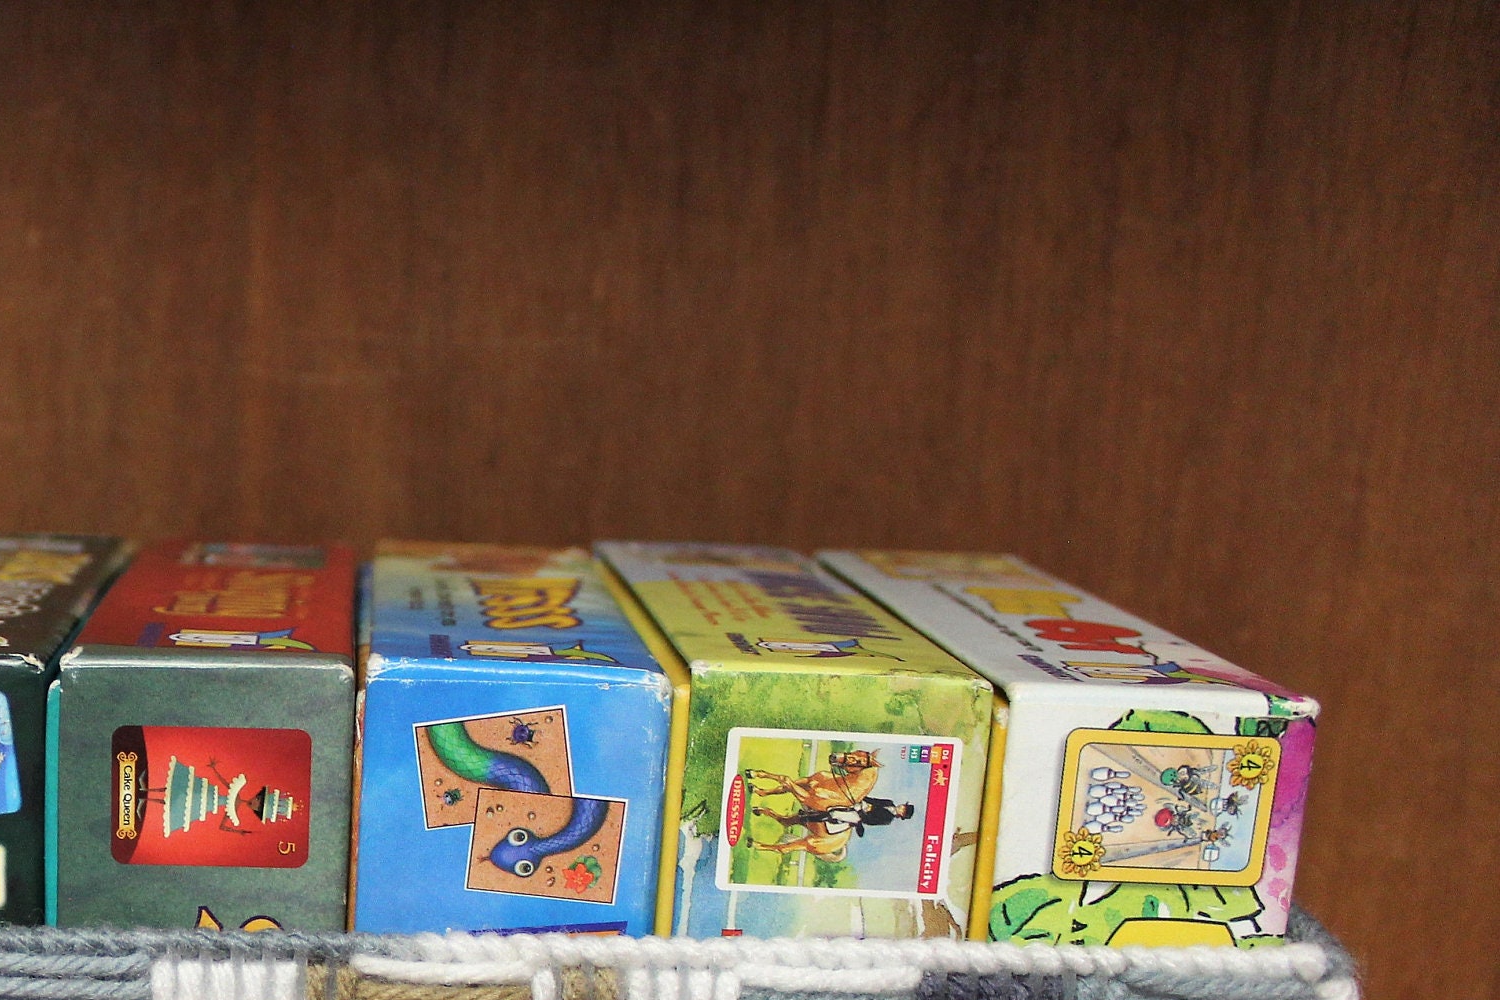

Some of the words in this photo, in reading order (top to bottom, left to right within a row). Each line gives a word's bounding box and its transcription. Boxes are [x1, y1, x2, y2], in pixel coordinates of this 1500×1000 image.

[123, 765, 133, 790] Cake
[1240, 759, 1262, 771] 4
[123, 792, 133, 826] Queen
[729, 780, 742, 842] DRESSAGE
[278, 841, 296, 855] 5
[1072, 846, 1093, 858] 4
[920, 835, 940, 890] Felicity
